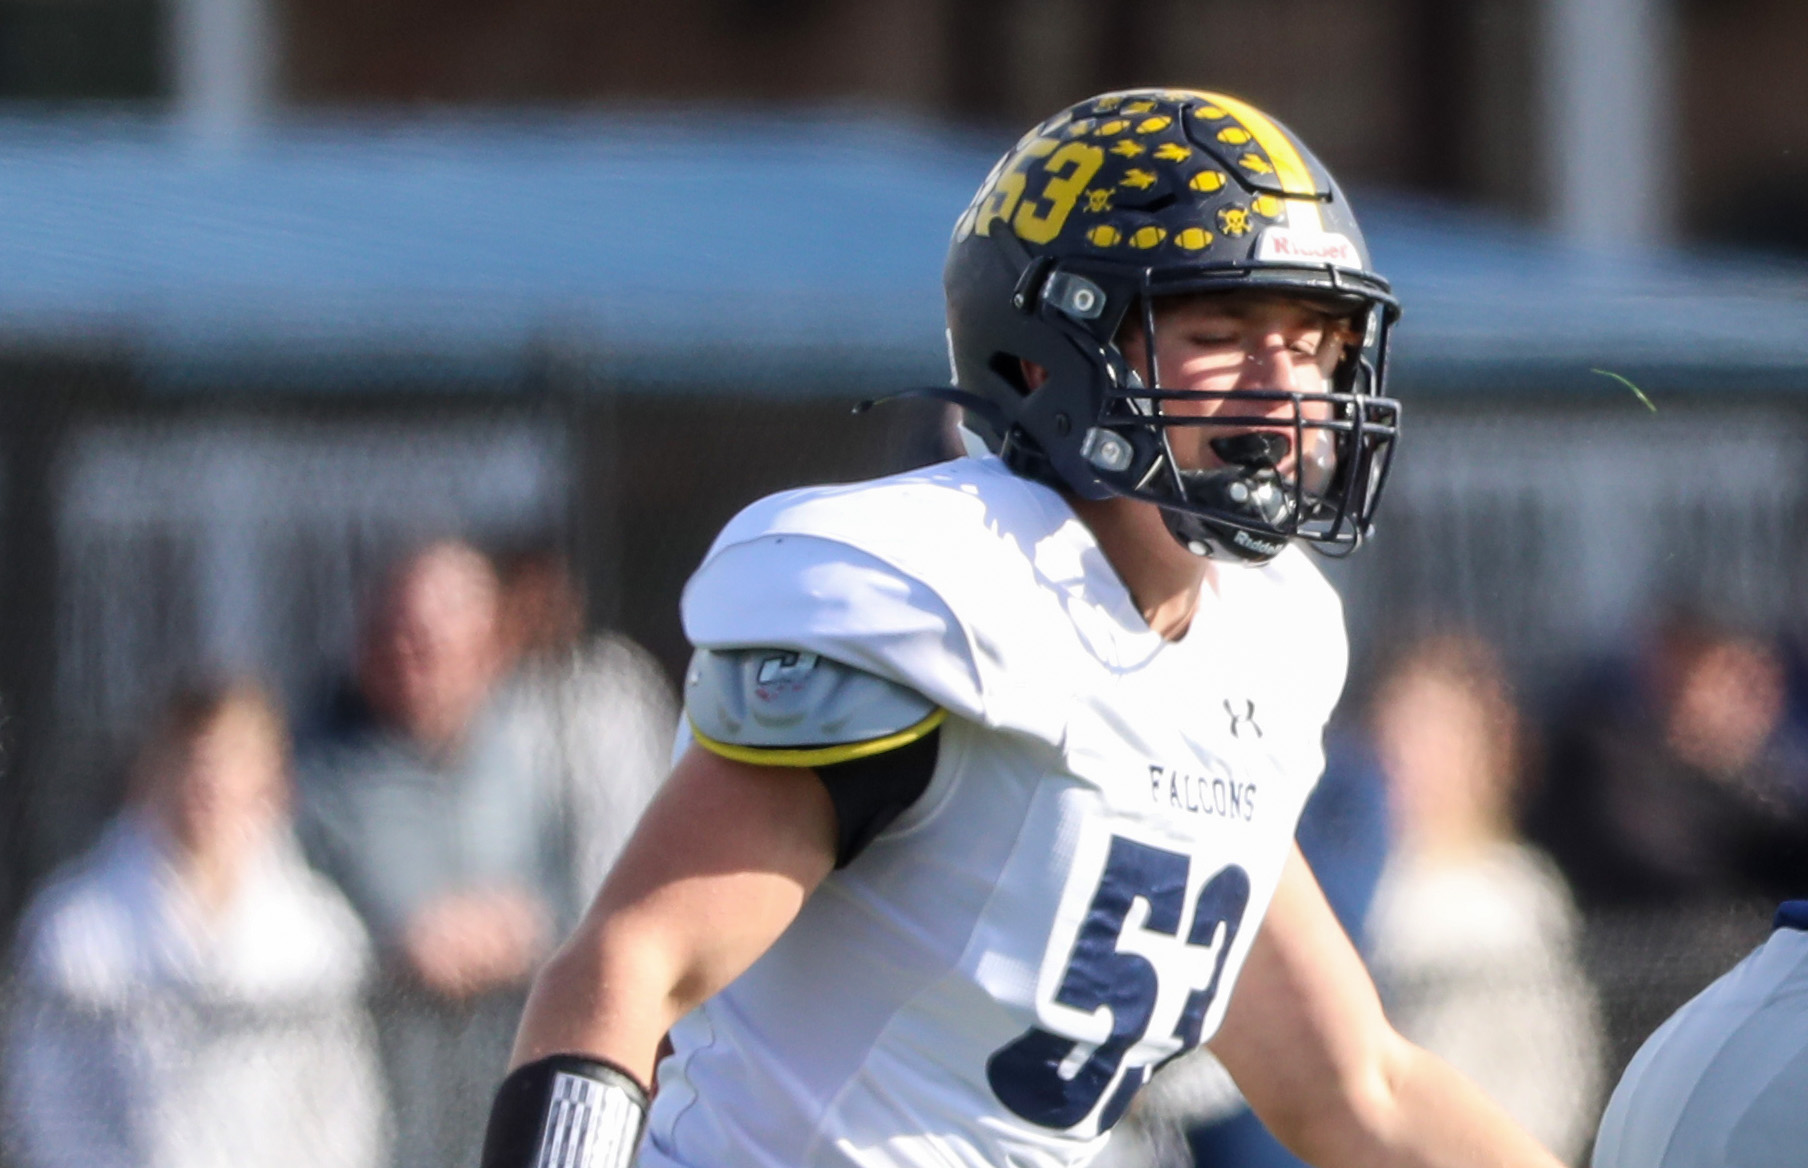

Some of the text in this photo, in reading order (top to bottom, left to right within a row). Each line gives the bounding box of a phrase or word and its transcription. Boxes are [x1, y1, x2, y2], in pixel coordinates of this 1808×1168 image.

[1272, 233, 1349, 259] Riel
[1233, 530, 1285, 556] Riddel
[1148, 764, 1257, 822] FALCONS
